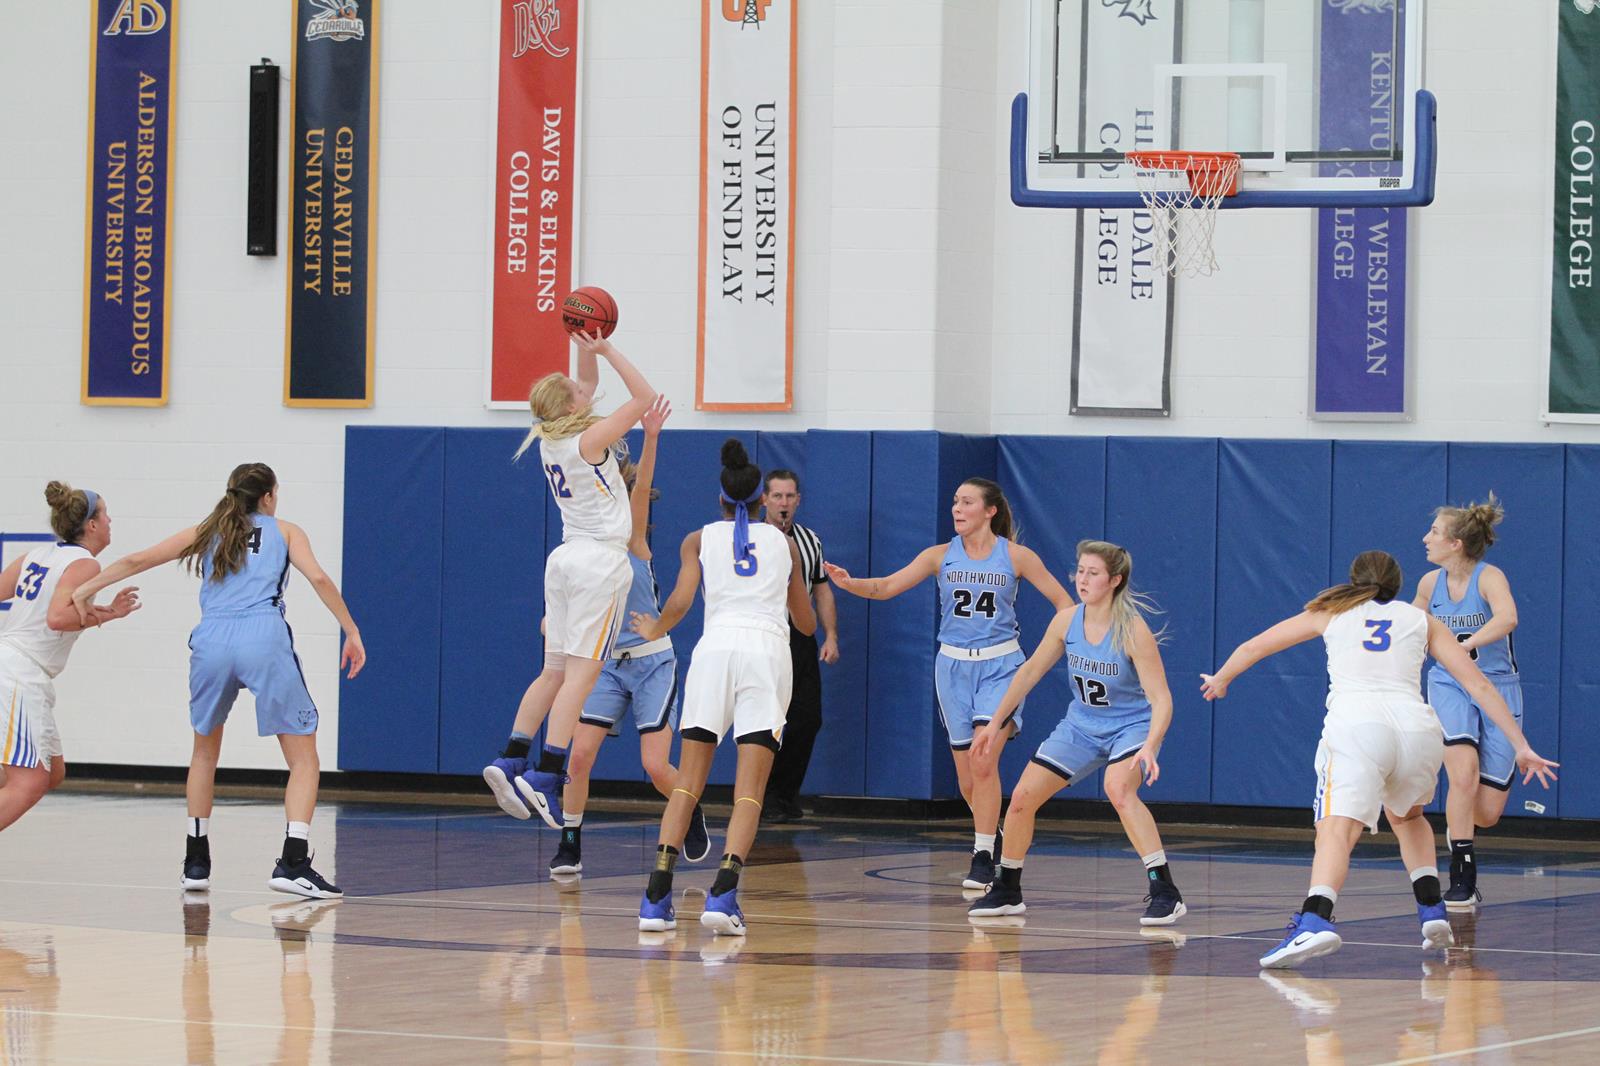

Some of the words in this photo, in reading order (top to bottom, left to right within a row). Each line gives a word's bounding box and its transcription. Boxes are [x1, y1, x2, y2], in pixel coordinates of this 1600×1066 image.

[135, 71, 157, 216] ALDERSON
[541, 106, 562, 182] DAVIS
[721, 105, 742, 150] OF
[1369, 50, 1392, 213] KENTUC
[105, 140, 127, 306] UNIVERSITY
[304, 128, 325, 296] UNIVERSITY
[333, 125, 354, 297] CEDARVILLE
[507, 150, 531, 274] COLLEGE
[540, 189, 559, 208] &
[721, 160, 743, 305] FINDLAY
[754, 100, 776, 307] UNIVERSITY
[1569, 120, 1595, 288] COLLEGE
[131, 225, 153, 376] BROADDUS
[537, 215, 559, 313] ELKINS
[1366, 219, 1389, 376] WESLEYAN
[545, 463, 573, 498] 12
[16, 562, 49, 601] 33
[733, 542, 758, 577] 5
[946, 571, 1007, 587] NORTHWOOD
[953, 589, 997, 619] 24
[1069, 653, 1119, 676] ORTHWOOD
[1363, 619, 1392, 652] 3
[1073, 674, 1111, 707] 12
